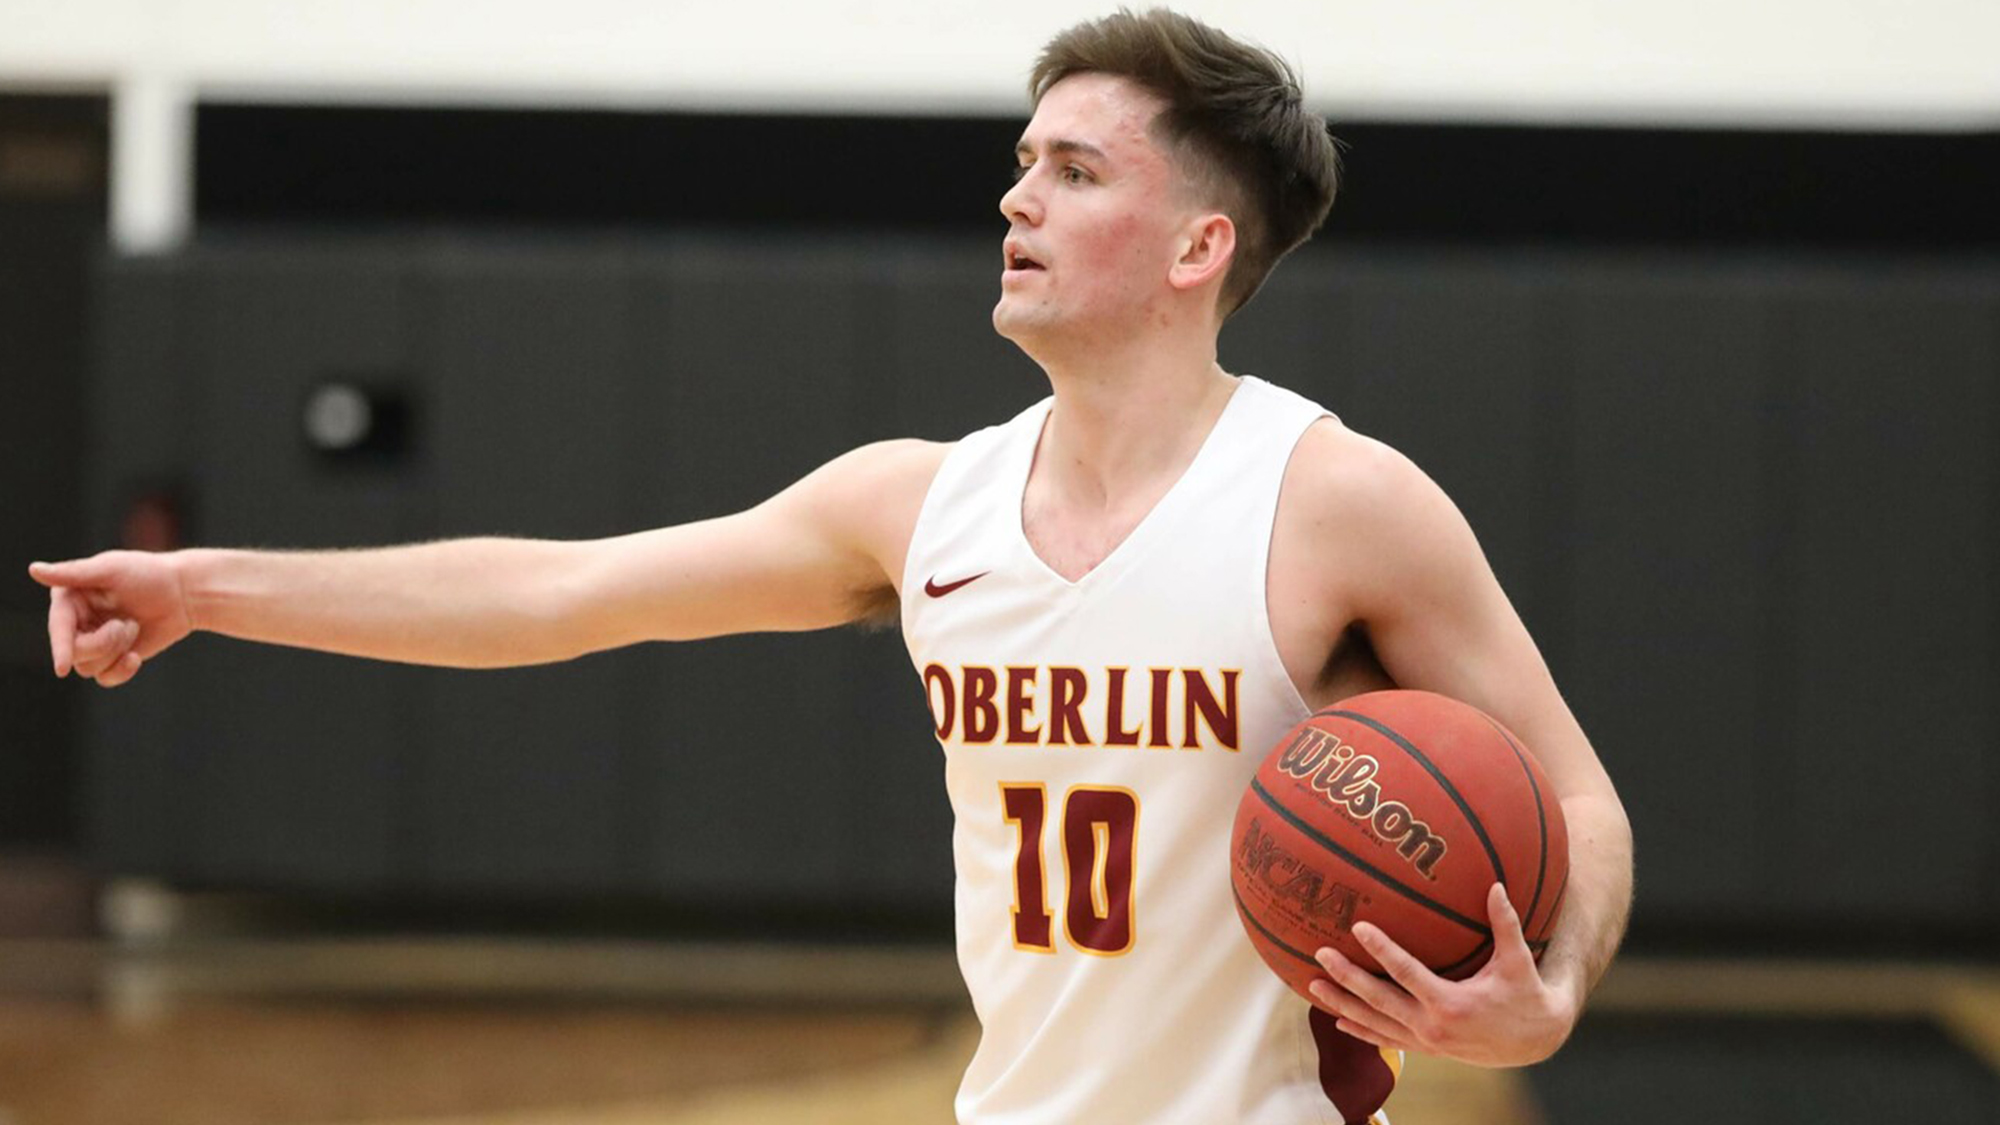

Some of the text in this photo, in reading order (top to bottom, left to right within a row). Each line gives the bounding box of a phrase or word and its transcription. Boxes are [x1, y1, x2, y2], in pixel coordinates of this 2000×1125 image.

[923, 663, 1243, 753] OBERLIN
[997, 780, 1141, 958] 10
[1277, 726, 1448, 880] Wilson
[1239, 816, 1361, 933] NCAA
